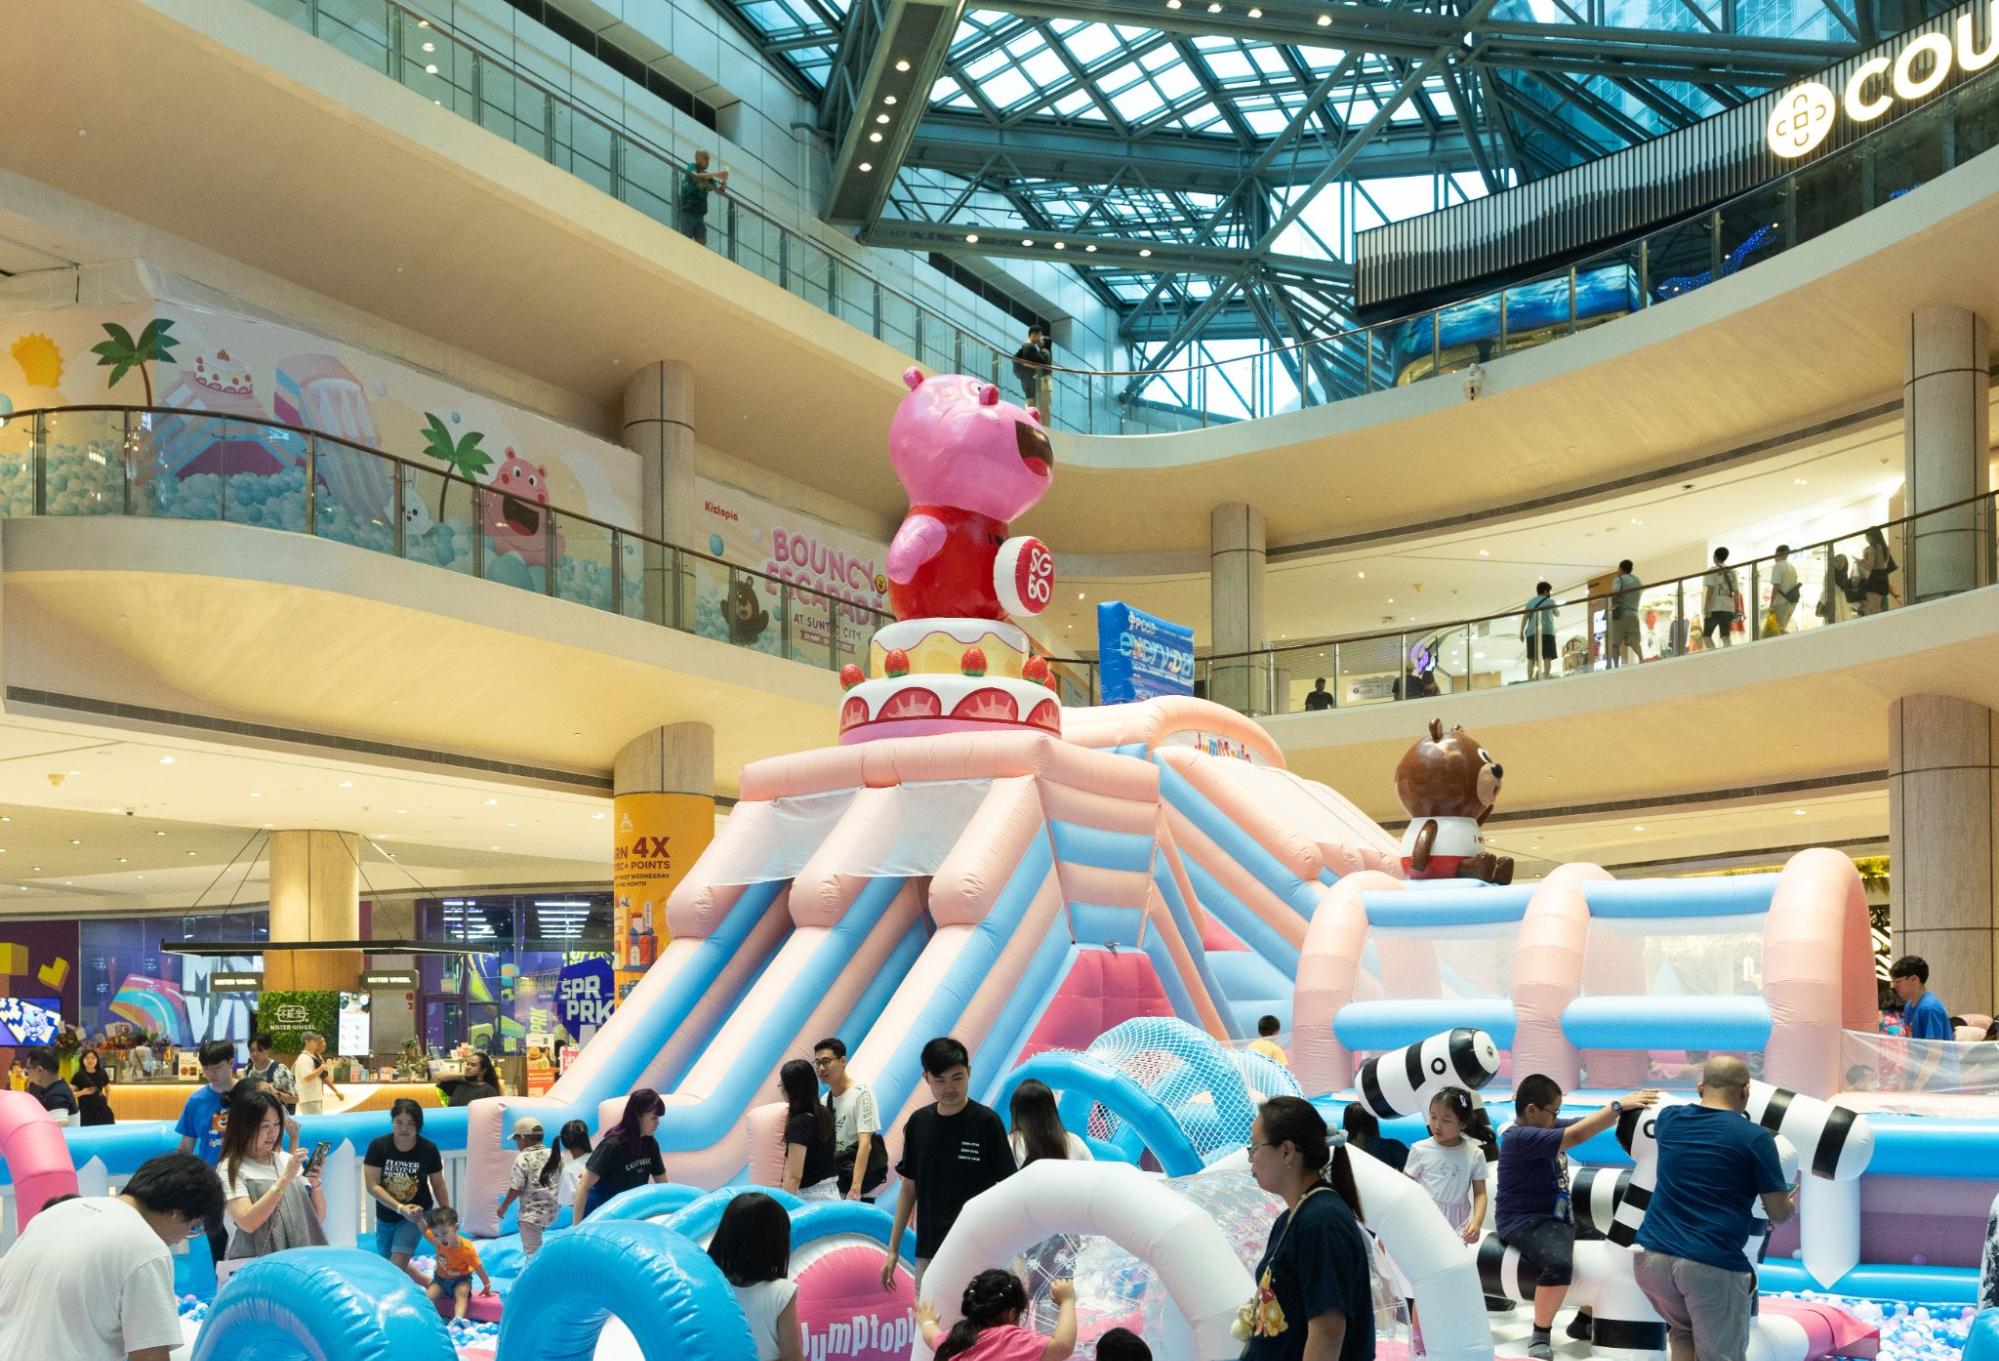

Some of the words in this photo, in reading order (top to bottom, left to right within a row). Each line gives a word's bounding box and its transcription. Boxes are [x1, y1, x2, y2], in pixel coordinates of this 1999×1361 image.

[1845, 0, 1999, 121] COU
[704, 501, 738, 521] Kiztopia
[773, 528, 876, 592] BOUNCY
[1031, 548, 1052, 576] SG
[1028, 574, 1050, 603] 60
[794, 613, 804, 625] AT
[843, 626, 862, 641] CITY
[632, 836, 671, 858] 4X
[631, 860, 671, 870] POINTS
[560, 975, 602, 1000] SPR
[566, 999, 615, 1025] PRK
